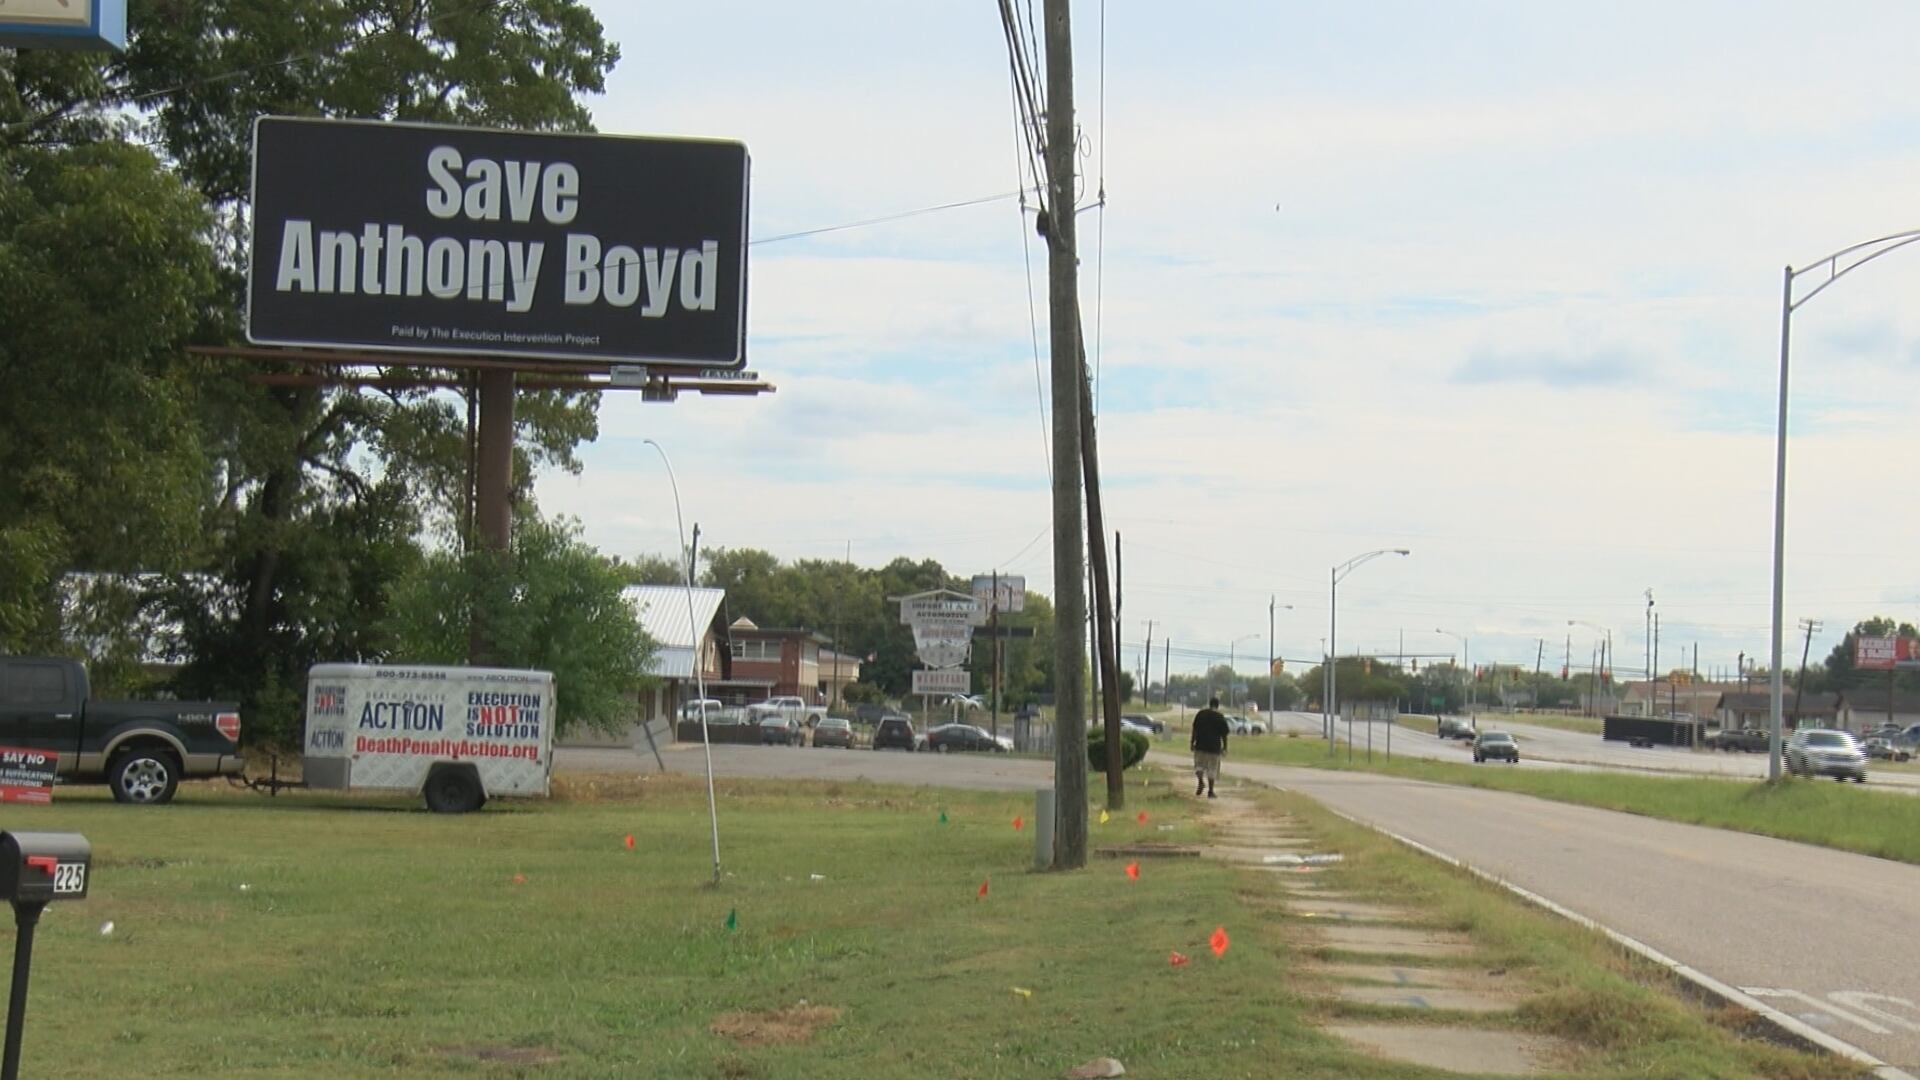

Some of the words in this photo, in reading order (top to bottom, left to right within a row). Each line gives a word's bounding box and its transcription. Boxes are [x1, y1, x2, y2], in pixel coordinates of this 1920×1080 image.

[426, 145, 580, 225] Save
[275, 219, 545, 313] Anthony
[563, 233, 719, 318] Boyd
[391, 325, 415, 337] Paid
[416, 326, 429, 340] by
[431, 327, 449, 339] The
[452, 328, 501, 341] Execution
[503, 332, 563, 344] Intervention
[565, 333, 600, 346] Project
[916, 611, 968, 619] AUTOMOTIVE
[468, 692, 541, 708] EXECUTION
[359, 701, 444, 731] ACTION
[467, 707, 479, 720] IS
[480, 705, 519, 726] NOT
[519, 710, 540, 724] THE
[311, 729, 344, 749] ACTION
[466, 722, 540, 739] SOLUTION
[3, 752, 25, 763] SAY
[26, 754, 46, 765] NO
[356, 736, 539, 760] DeathPenaltyAction.org
[55, 865, 82, 890] 225
